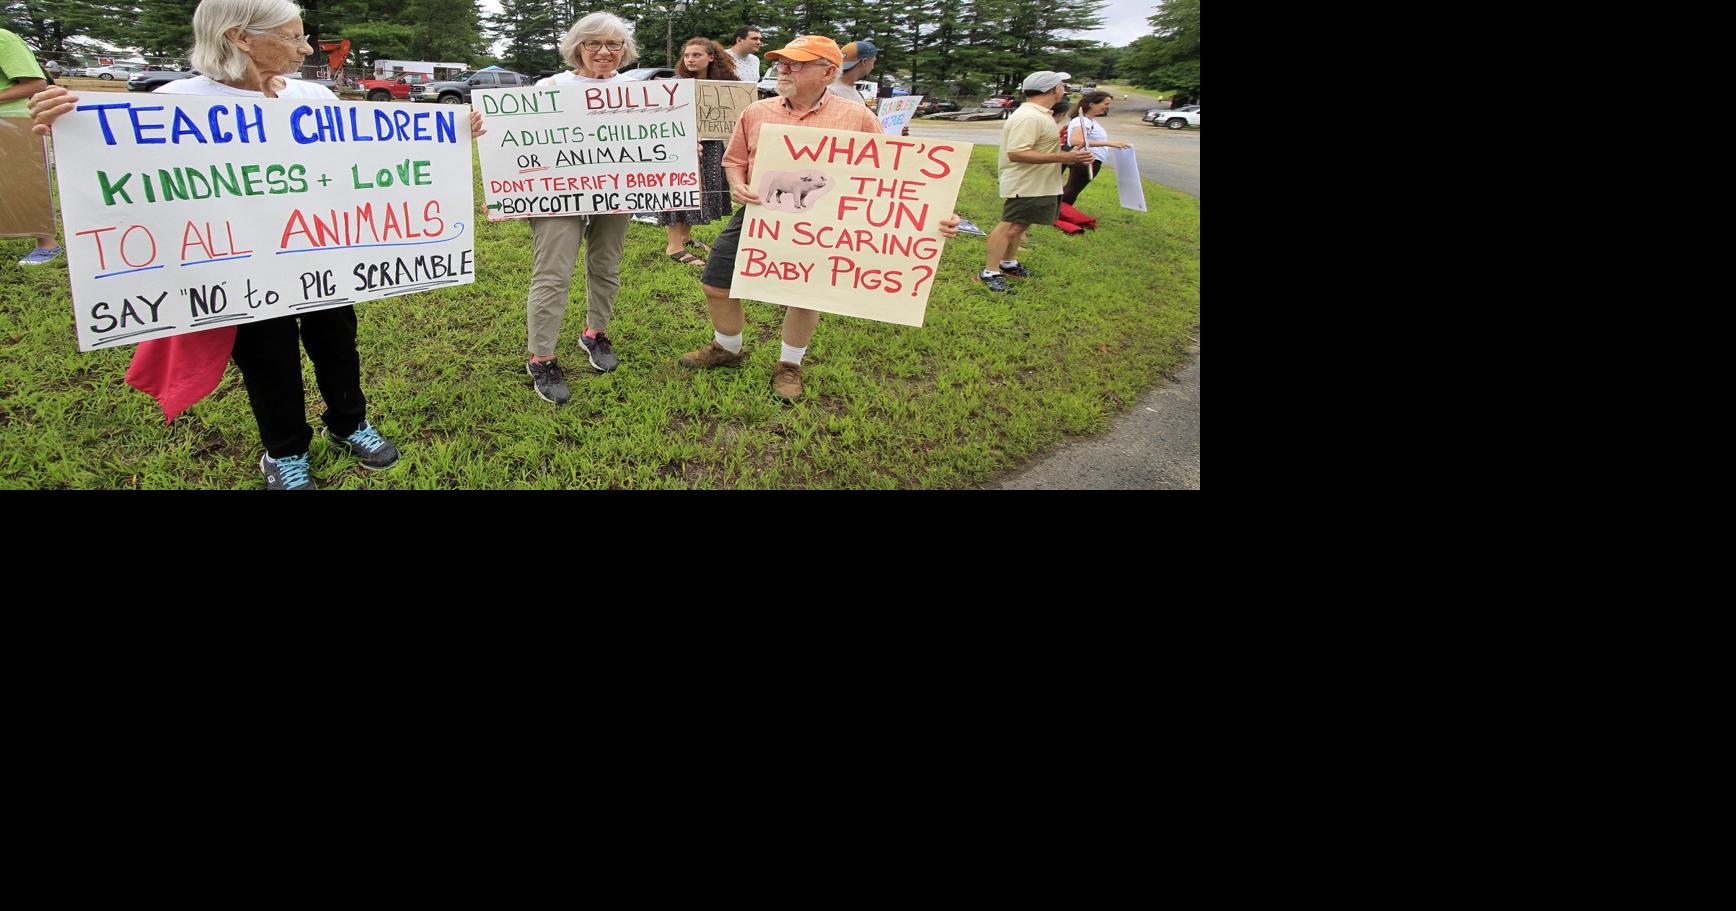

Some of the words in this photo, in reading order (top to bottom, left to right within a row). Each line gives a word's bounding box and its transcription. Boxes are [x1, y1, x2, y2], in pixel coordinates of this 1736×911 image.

[482, 90, 560, 115] DON'T
[585, 83, 679, 110] BULLY
[699, 106, 729, 121] NOT
[76, 102, 267, 146] TEACH
[290, 104, 457, 145] CHILDREN
[501, 121, 686, 148] ADULTS-CHILDREN
[517, 154, 541, 168] OR
[555, 144, 667, 166] ANIMALS
[783, 134, 955, 179] WHAT'S
[96, 162, 309, 206] KINDNESS
[352, 159, 432, 190] LOVE
[540, 174, 620, 191] TERRIFY
[626, 173, 667, 189] BABY
[669, 171, 698, 187] PIGS
[850, 176, 927, 201] THE
[502, 193, 585, 214] BOYCOTT
[592, 193, 621, 212] PIG
[625, 190, 700, 211] SCRAMBLE
[837, 196, 929, 232] FUN
[75, 226, 157, 270] TO
[180, 220, 253, 261] ALL
[280, 200, 445, 249] ANIMALS
[748, 218, 781, 241] IN
[791, 221, 939, 261] SCARING
[740, 247, 815, 283] BABY
[90, 290, 169, 334] SAY
[244, 278, 280, 310] to
[299, 269, 336, 301] PIG
[353, 249, 474, 293] SCRAMBLE
